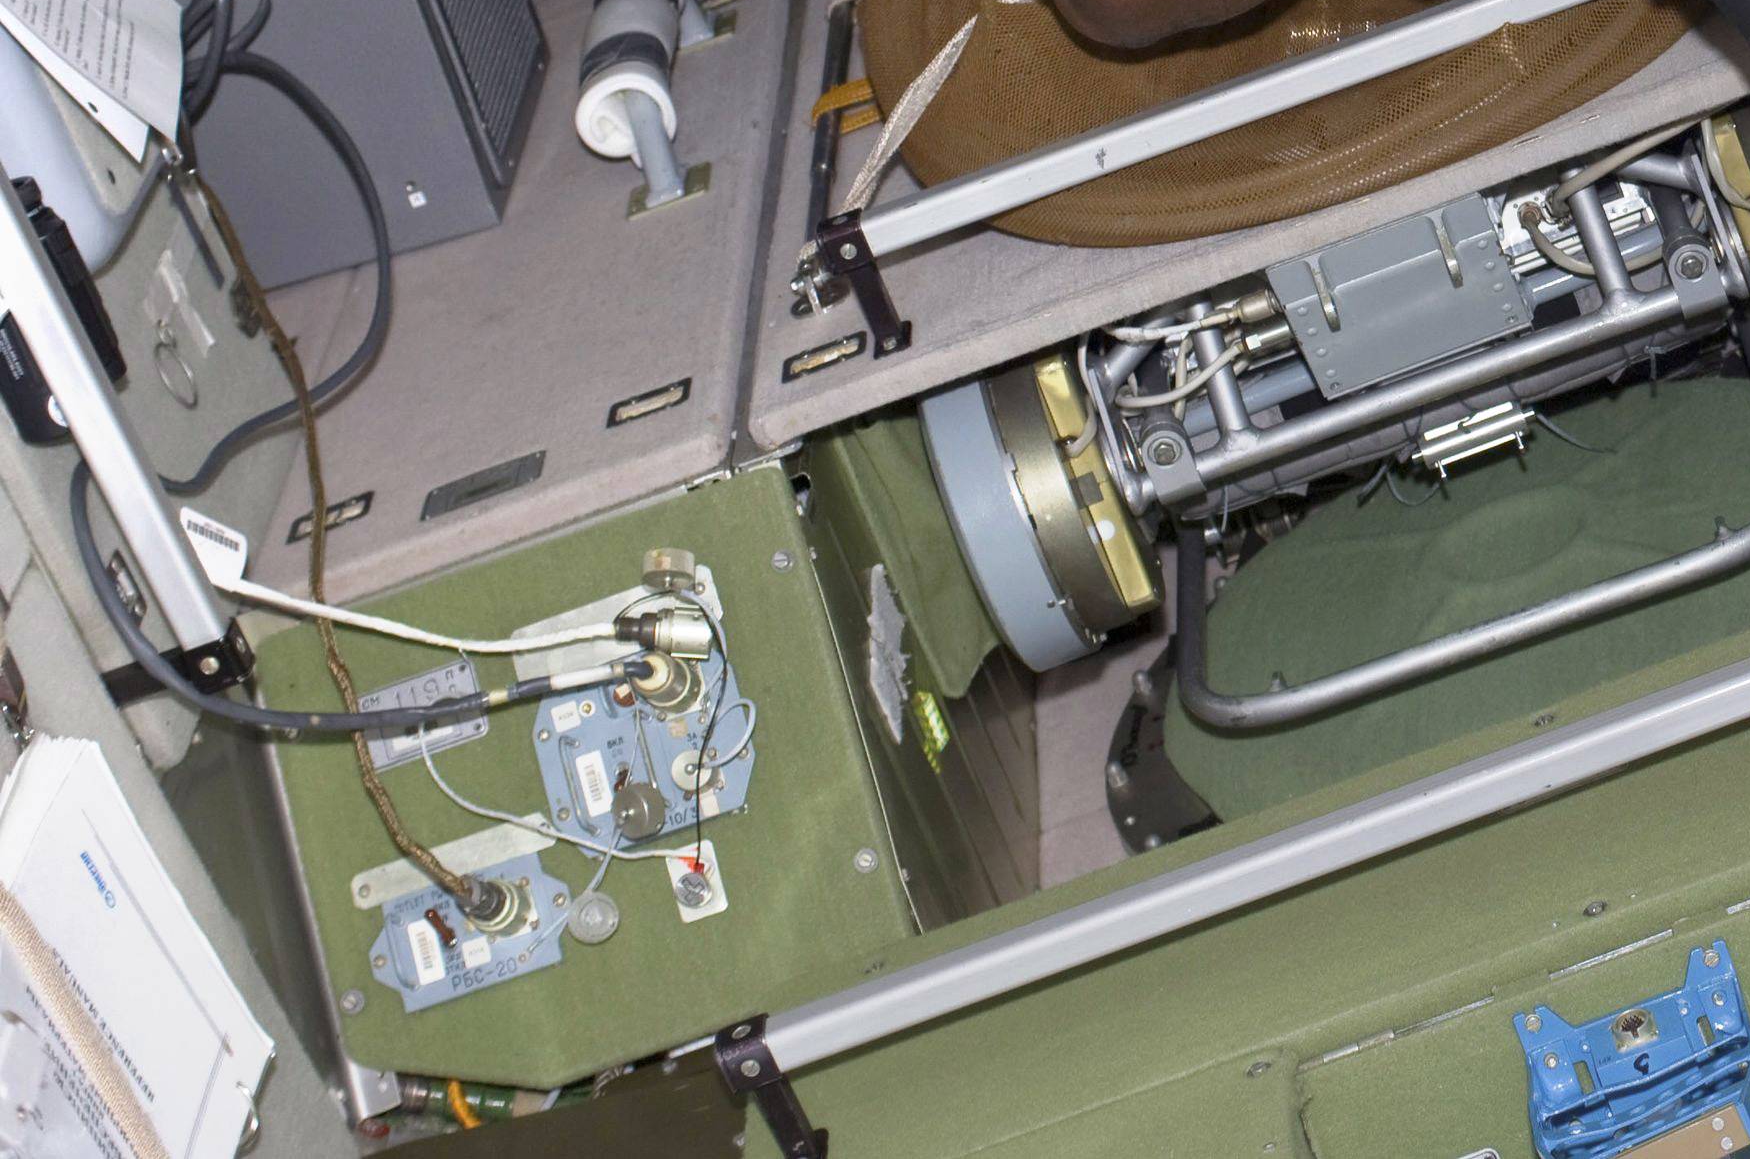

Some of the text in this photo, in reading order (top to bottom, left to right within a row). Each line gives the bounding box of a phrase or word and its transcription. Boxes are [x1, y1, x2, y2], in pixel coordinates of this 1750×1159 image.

[394, 678, 440, 708] 119
[51, 947, 101, 1021] MANUALS
[451, 955, 518, 993] РБС-20
